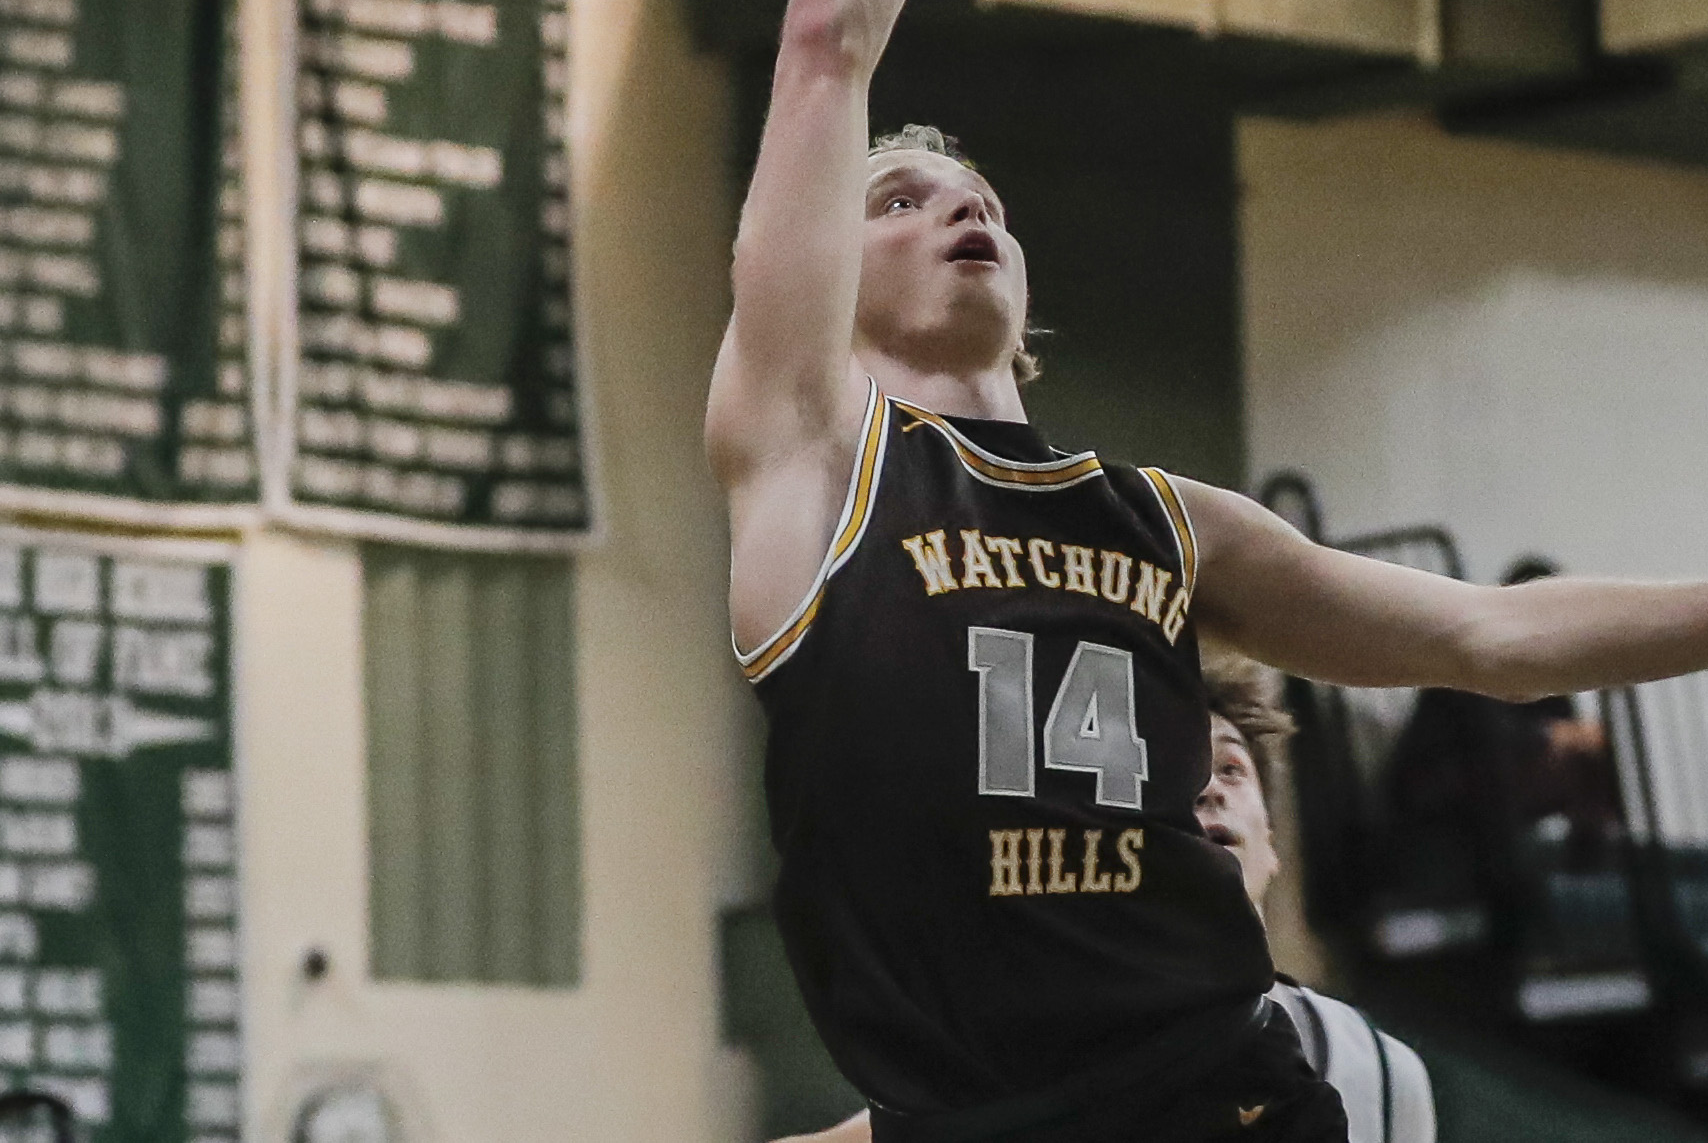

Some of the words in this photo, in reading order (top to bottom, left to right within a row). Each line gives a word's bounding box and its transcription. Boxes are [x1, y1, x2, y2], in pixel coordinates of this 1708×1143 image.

[902, 528, 1193, 647] WATCHUNG
[967, 625, 1148, 811] 14
[989, 827, 1145, 898] HILLS
